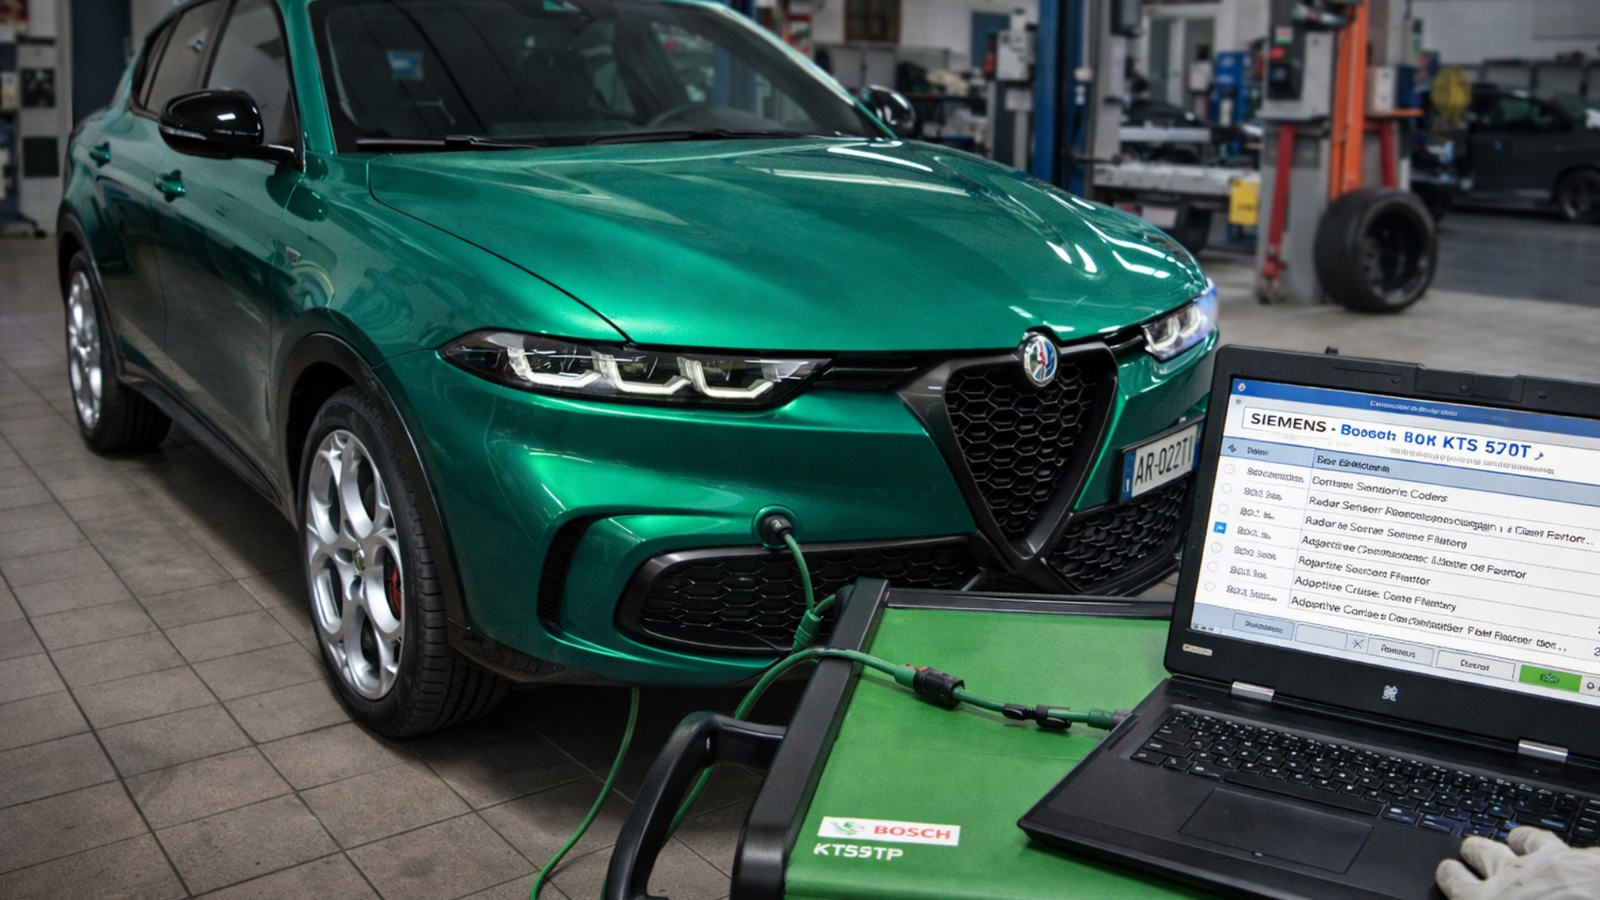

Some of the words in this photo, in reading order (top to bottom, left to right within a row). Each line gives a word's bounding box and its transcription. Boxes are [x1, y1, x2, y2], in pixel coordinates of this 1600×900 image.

[1250, 412, 1327, 433] SIEMENS
[1442, 435, 1478, 452] KTS
[873, 825, 951, 840] BOSCH
